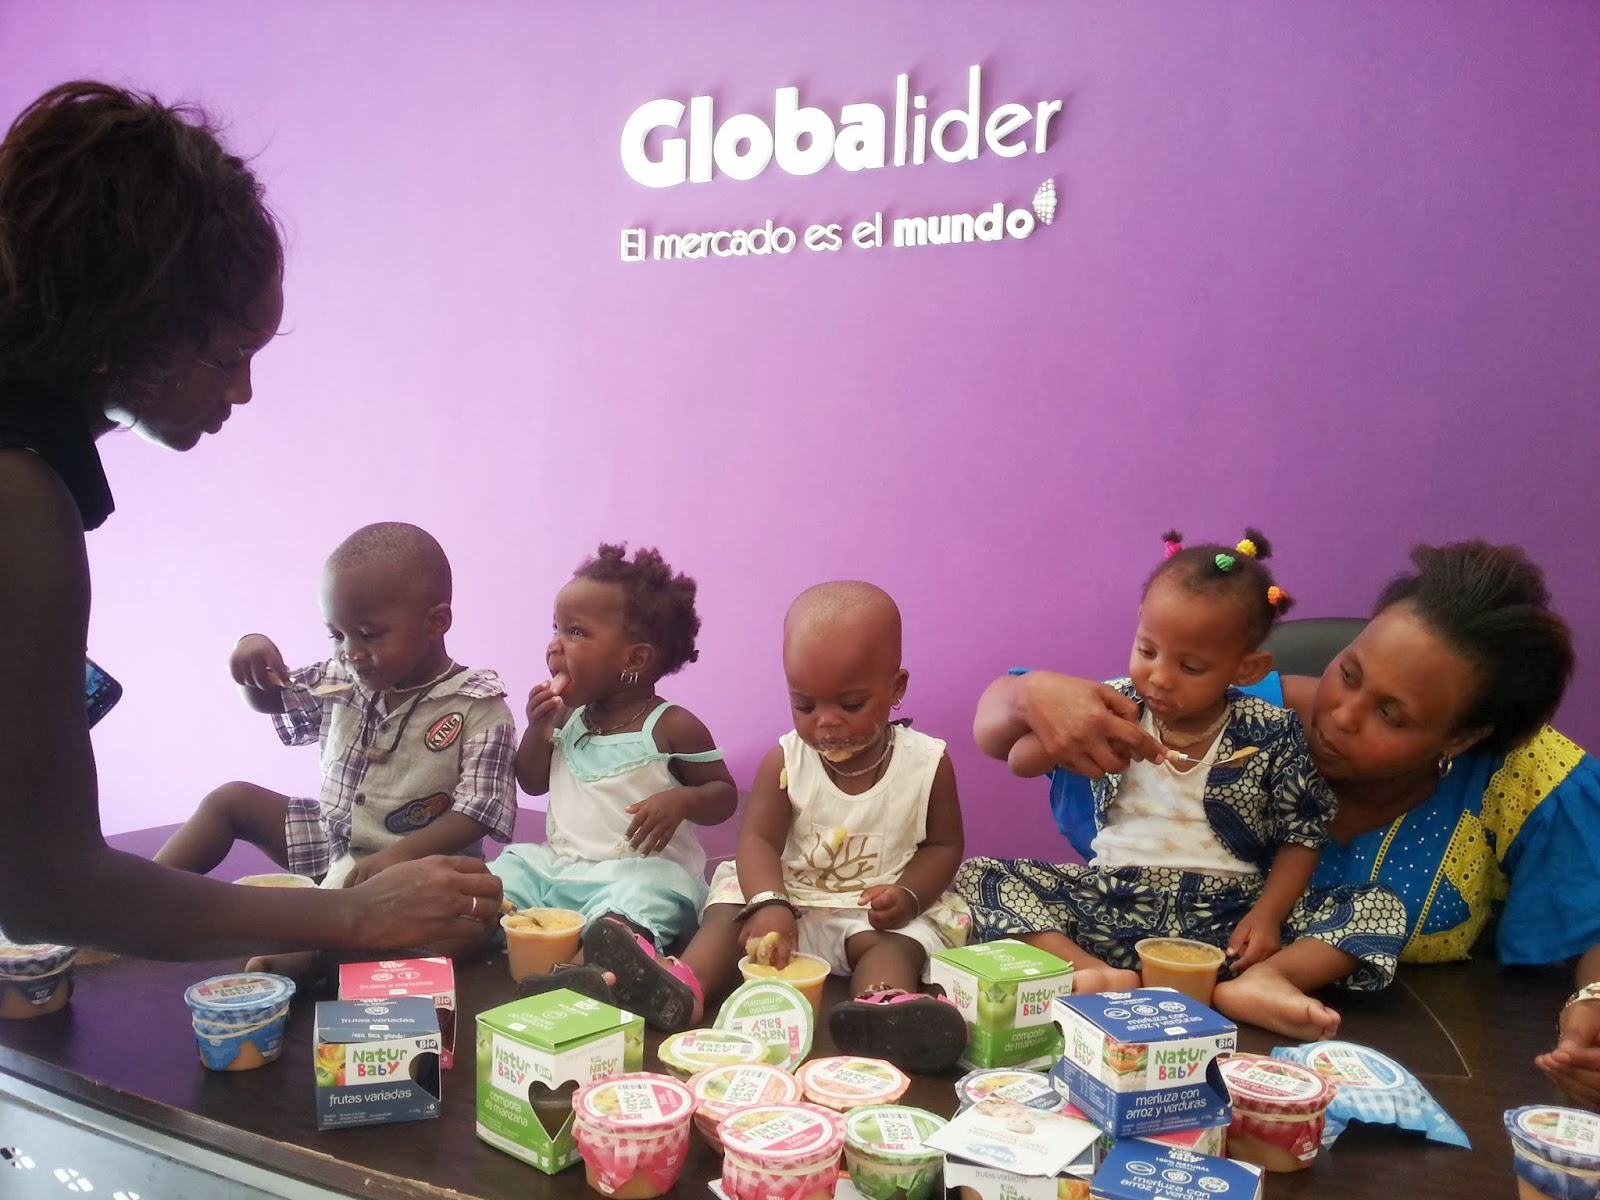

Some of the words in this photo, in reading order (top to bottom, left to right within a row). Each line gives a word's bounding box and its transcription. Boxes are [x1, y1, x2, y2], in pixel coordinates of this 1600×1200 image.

[620, 64, 1063, 188] Globalider
[620, 228, 647, 262] El
[653, 218, 797, 260] mercado
[804, 222, 843, 252] es
[851, 211, 883, 249] el
[893, 202, 1036, 247] mundo
[428, 714, 460, 749] KING
[329, 1094, 362, 1107] frutas
[364, 1089, 412, 1102] variadas
[490, 1091, 522, 1113] compota
[1135, 1092, 1178, 1107] merluza
[1180, 1088, 1200, 1100] con
[484, 1099, 493, 1110] de
[493, 1104, 528, 1127] manzana
[1126, 1107, 1153, 1120] arroz
[1155, 1106, 1162, 1118] y
[1163, 1098, 1207, 1114] verduras
[976, 1170, 996, 1180] frutas
[1175, 1161, 1211, 1172] NATURAL
[1120, 1179, 1153, 1192] arroz
[1133, 1176, 1184, 1192] merluza
[1186, 1187, 1211, 1199] con
